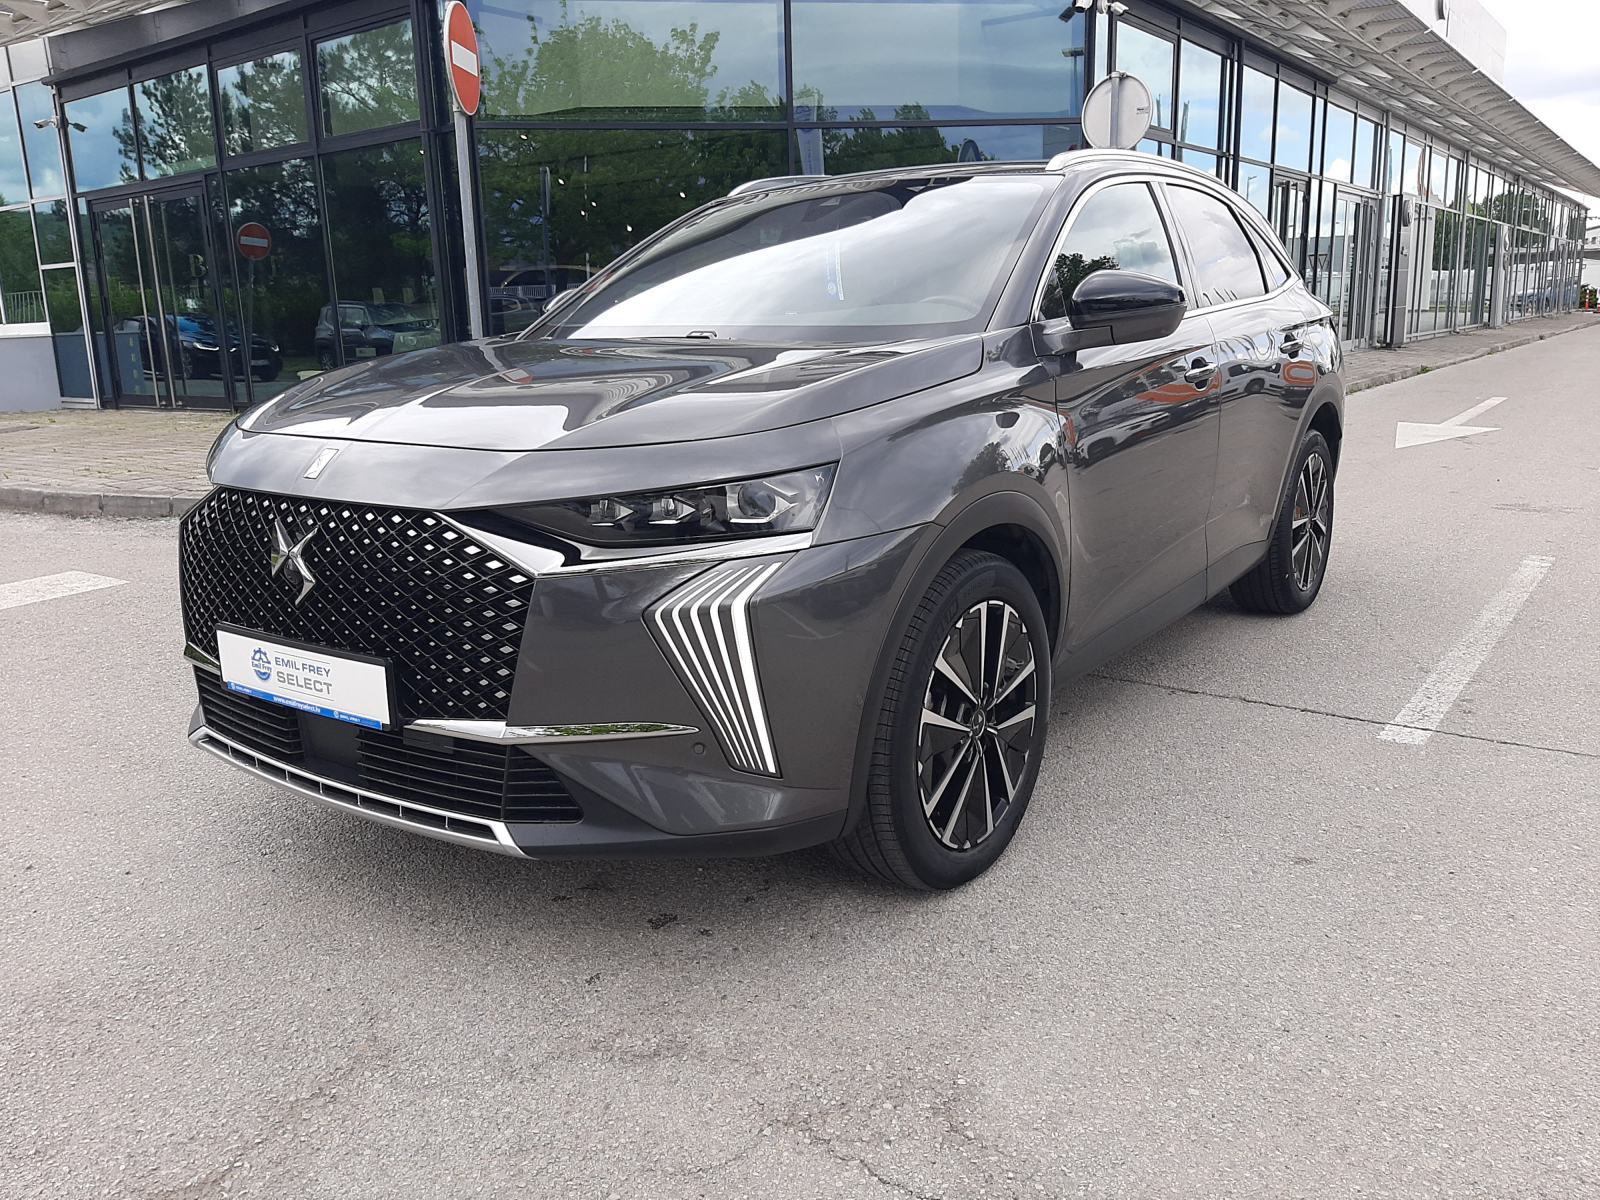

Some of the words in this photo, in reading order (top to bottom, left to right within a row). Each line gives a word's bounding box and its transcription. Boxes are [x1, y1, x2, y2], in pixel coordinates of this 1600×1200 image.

[275, 656, 300, 671] EMIL
[301, 662, 331, 677] FREY
[276, 671, 333, 694] SELECT
